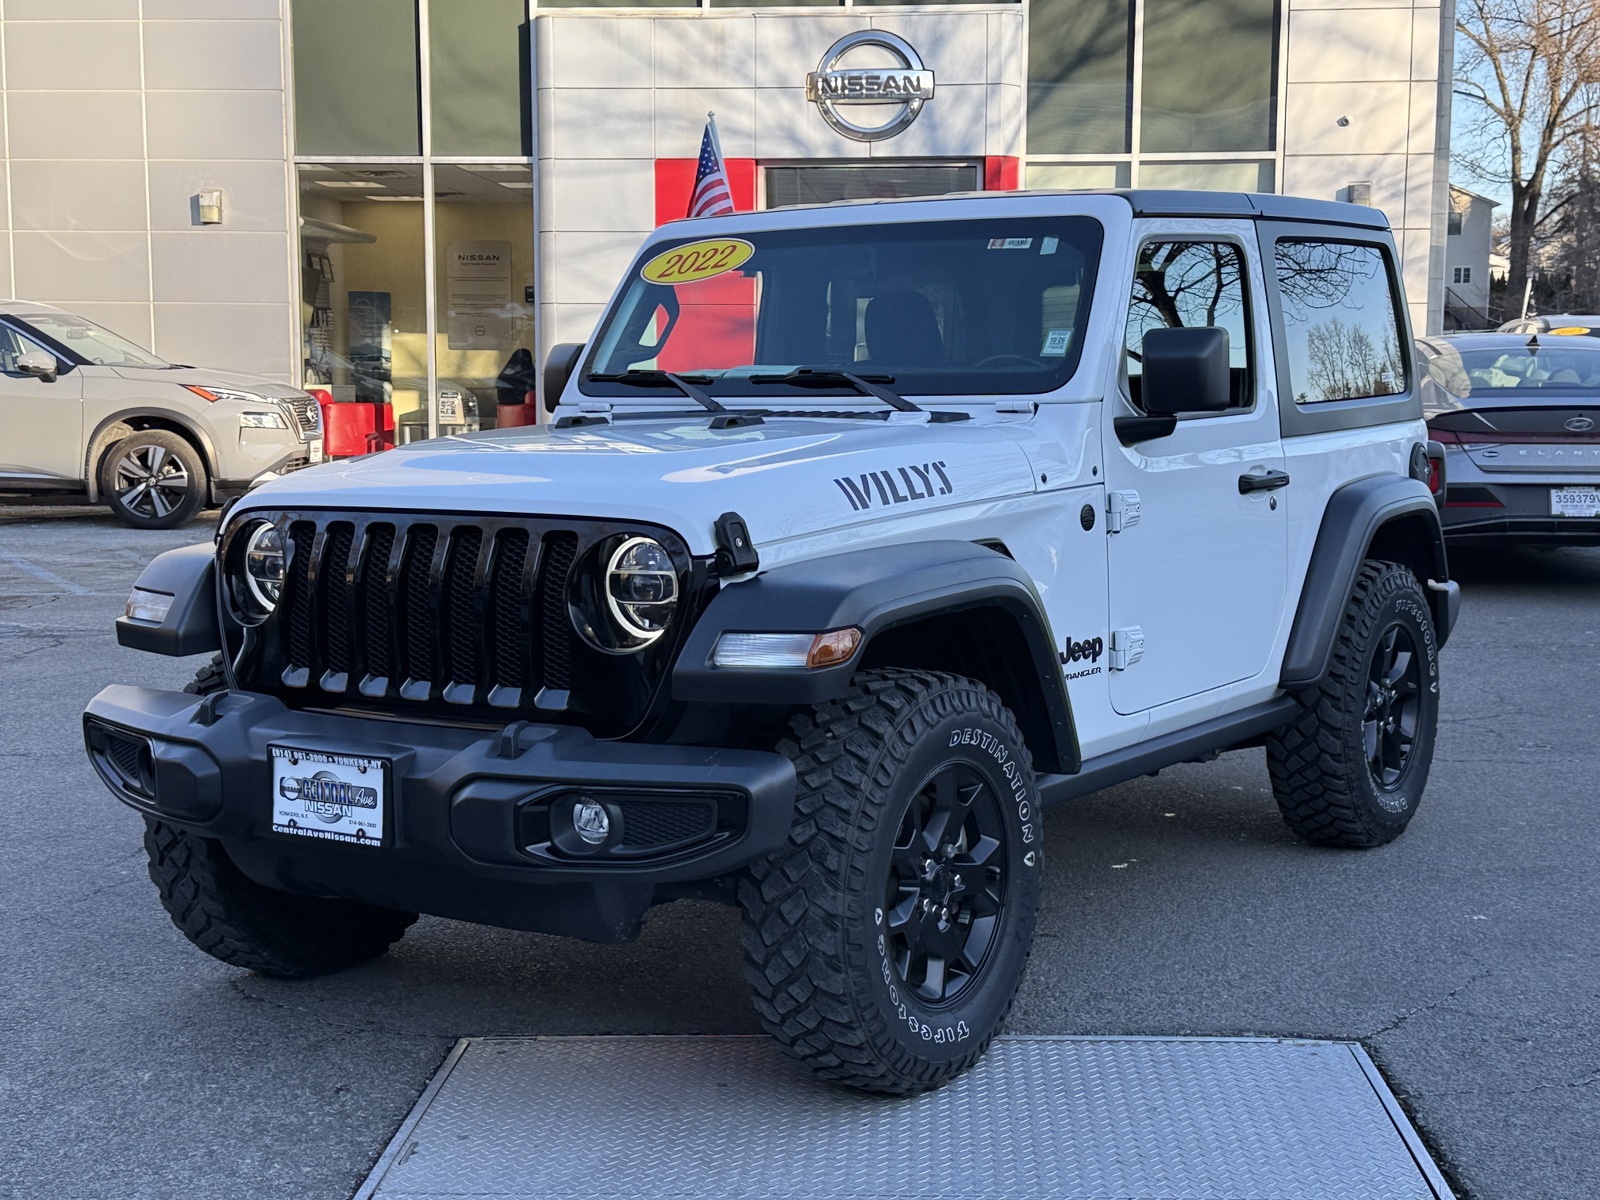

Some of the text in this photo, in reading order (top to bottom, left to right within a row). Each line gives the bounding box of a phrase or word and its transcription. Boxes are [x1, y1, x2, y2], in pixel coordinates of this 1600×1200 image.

[817, 75, 921, 95] NISSAN
[657, 244, 737, 279] 2022
[833, 461, 953, 511] WILLYS
[1059, 636, 1103, 664] Jeep
[302, 778, 375, 806] CENTRAL Ave.
[949, 728, 1034, 843] DESTINATION
[305, 800, 352, 818] NISSAN
[272, 824, 381, 847] CentralAveNissan.com
